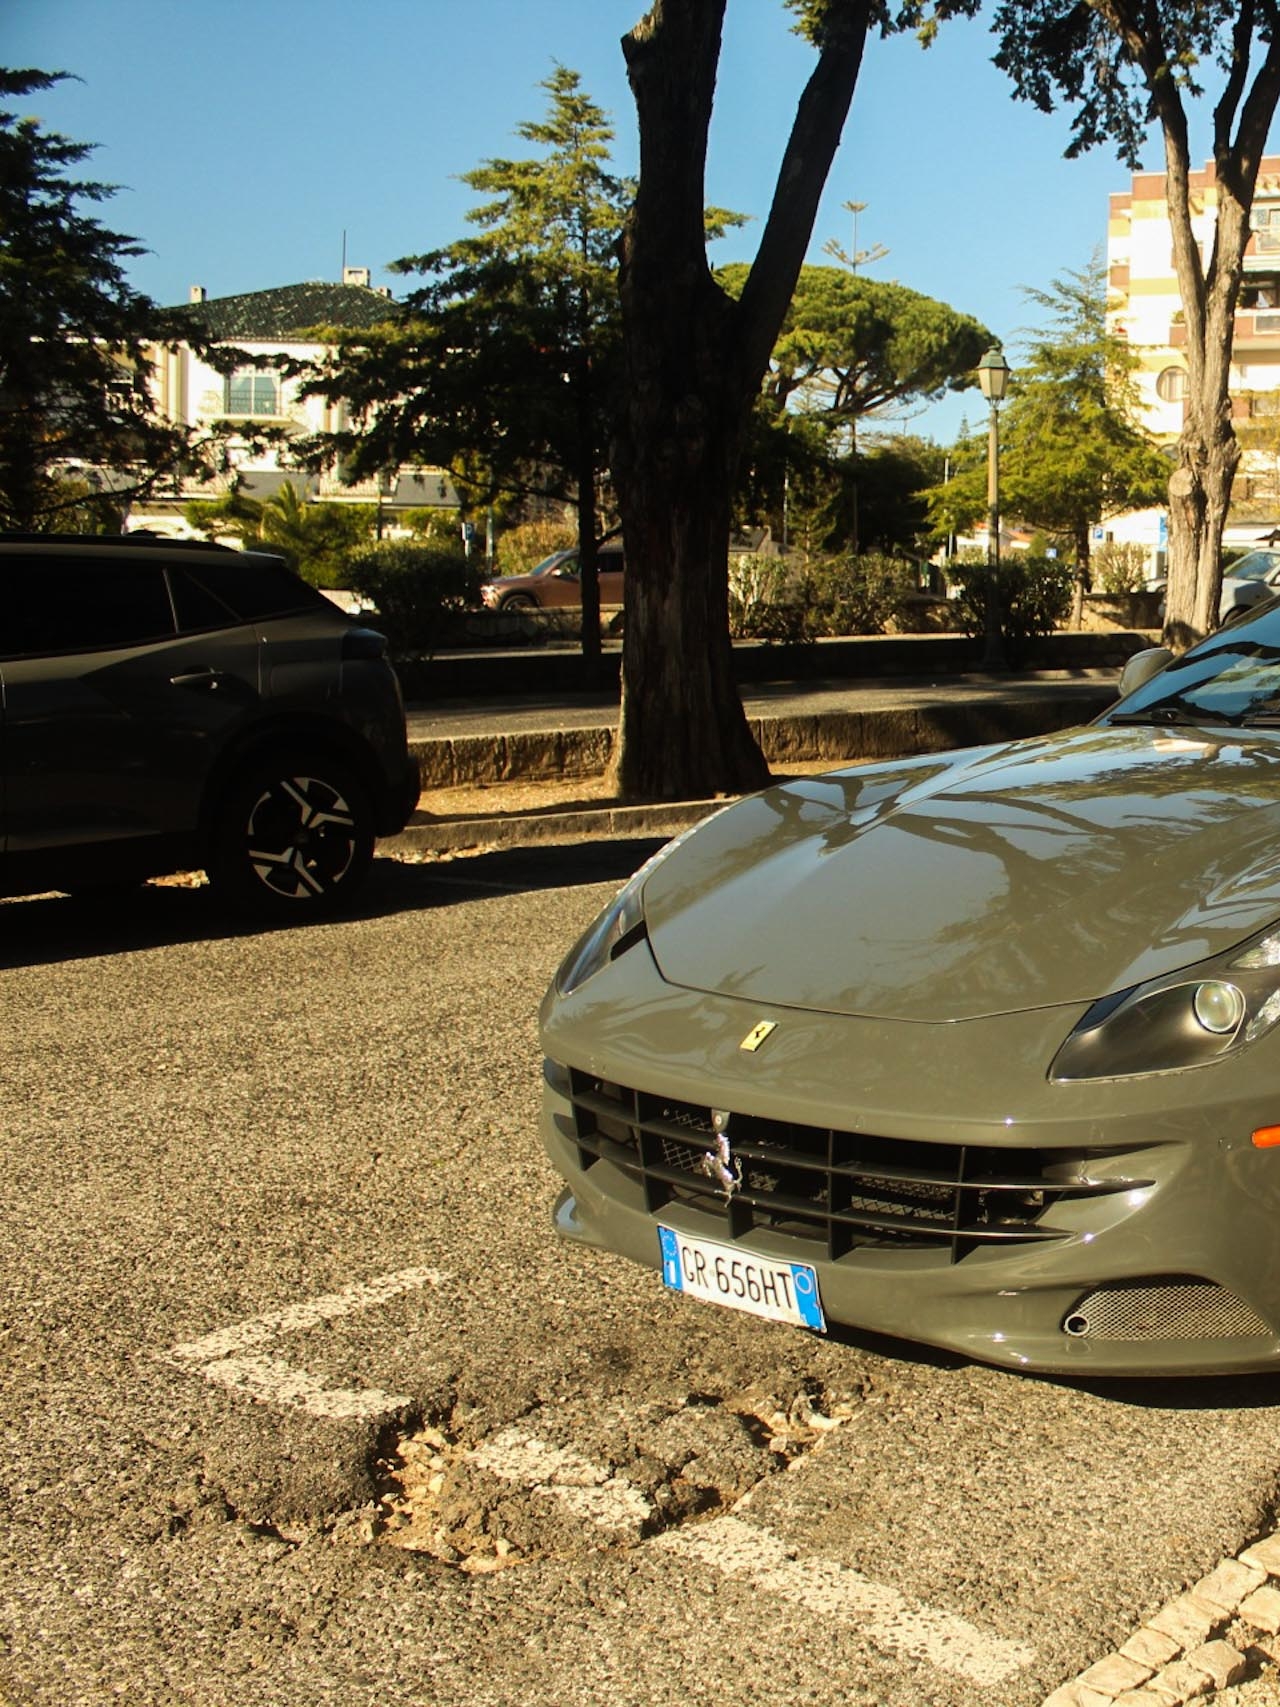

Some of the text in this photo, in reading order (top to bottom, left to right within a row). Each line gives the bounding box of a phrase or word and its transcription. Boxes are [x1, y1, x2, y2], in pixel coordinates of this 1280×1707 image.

[669, 1260, 676, 1284] I
[681, 1246, 792, 1309] GR 656HT
